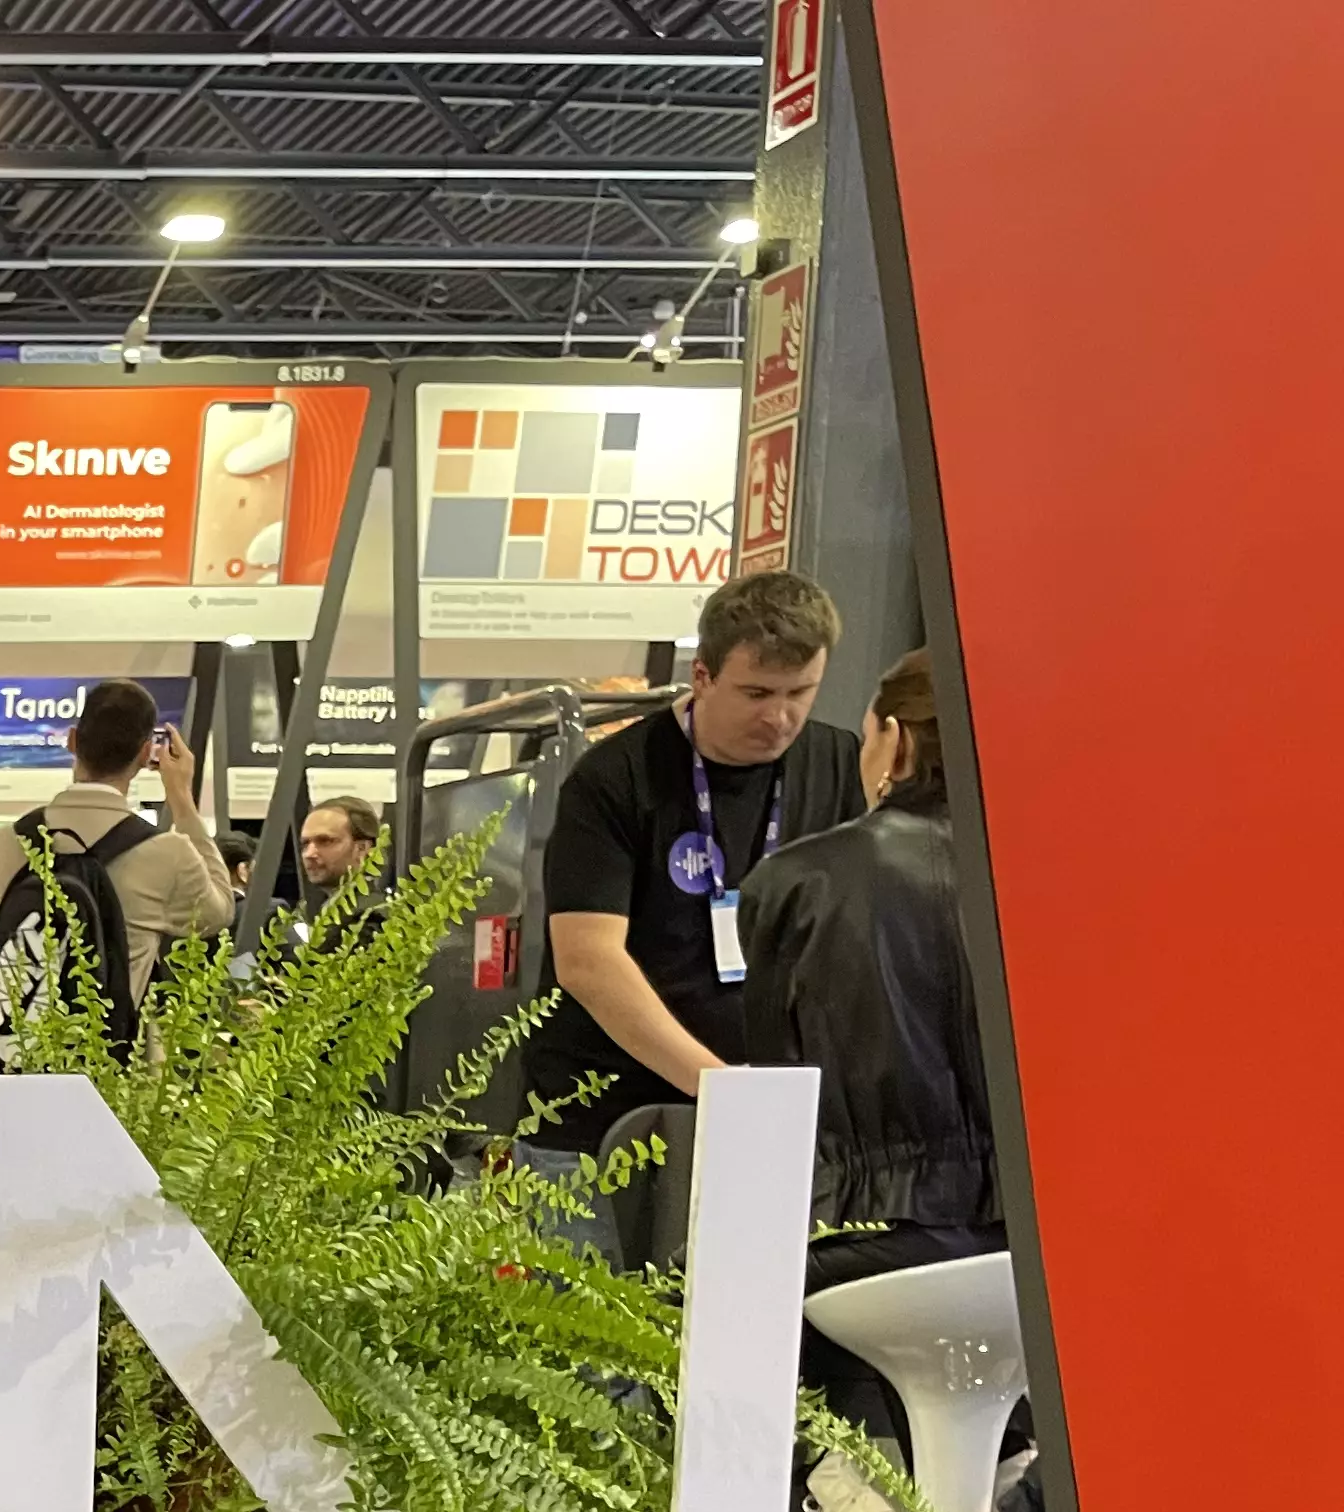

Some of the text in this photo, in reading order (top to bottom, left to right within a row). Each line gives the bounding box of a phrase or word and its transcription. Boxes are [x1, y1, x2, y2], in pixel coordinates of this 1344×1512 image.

[7, 440, 171, 477] Skinive
[23, 504, 165, 523] AI Dermatologist
[0, 523, 164, 542] in your smartphone
[318, 703, 387, 723] Battery
